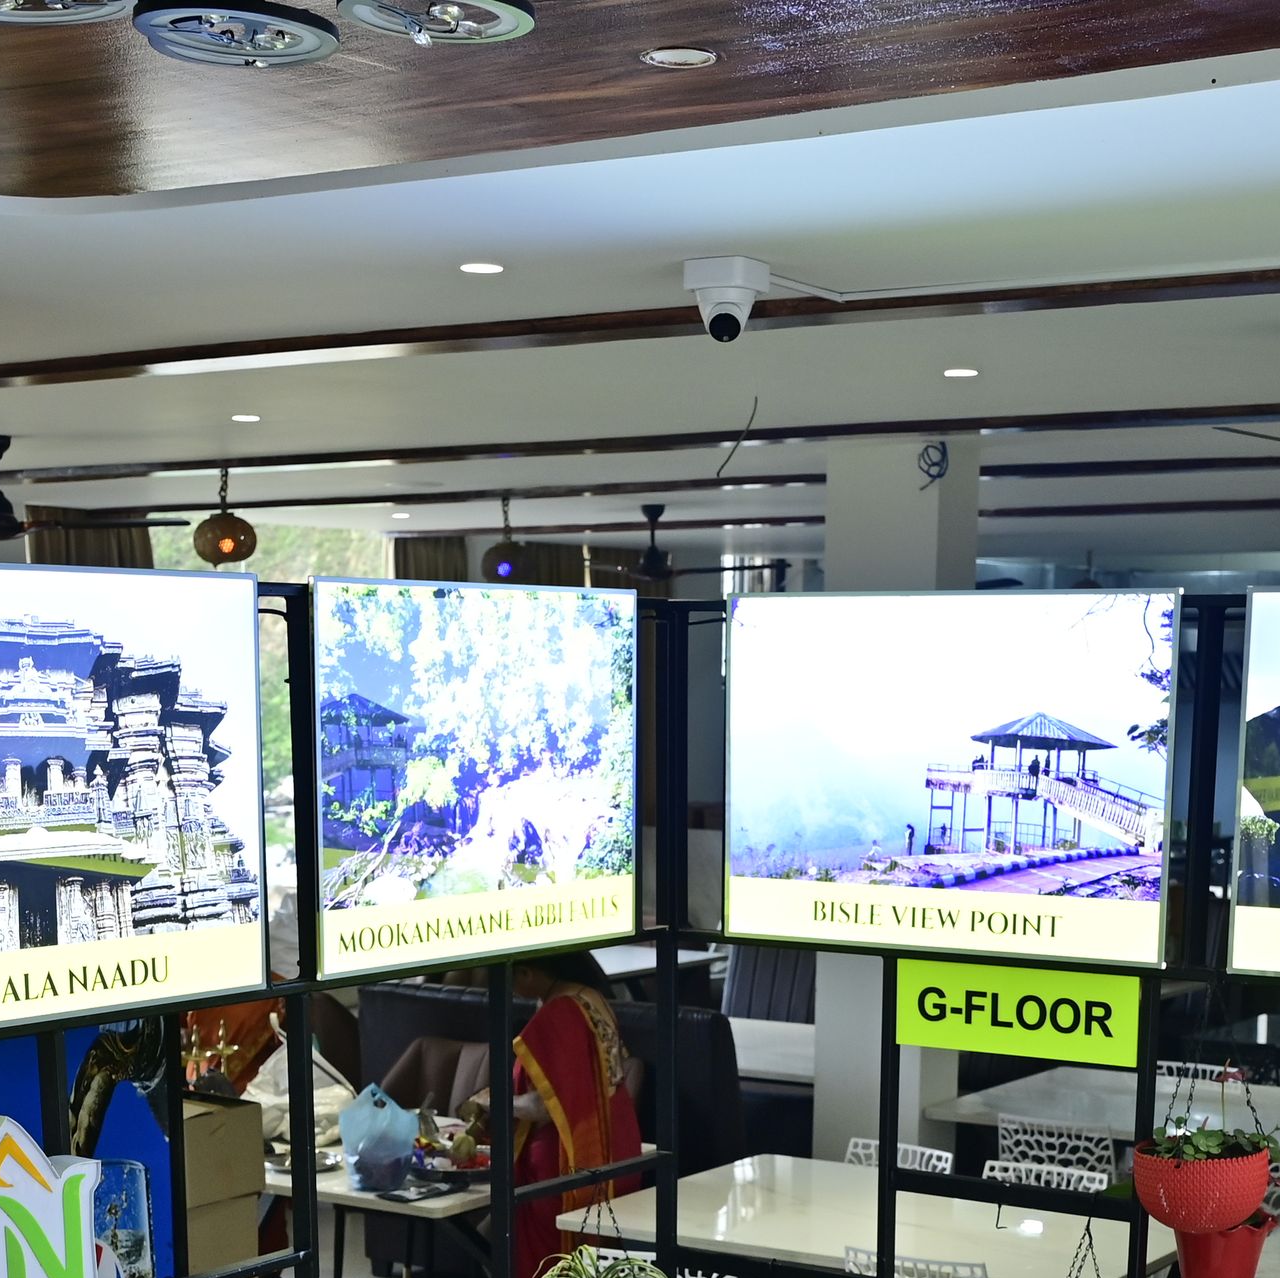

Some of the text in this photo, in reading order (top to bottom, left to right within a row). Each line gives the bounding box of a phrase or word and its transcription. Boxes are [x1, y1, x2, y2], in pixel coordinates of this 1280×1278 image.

[338, 907, 515, 955] MOOKANAMANE
[520, 901, 563, 929] ABBI
[812, 899, 1064, 938] BISLE VIEW POINT
[68, 955, 169, 995] NAADU
[916, 986, 1115, 1038] G-FLOOR
